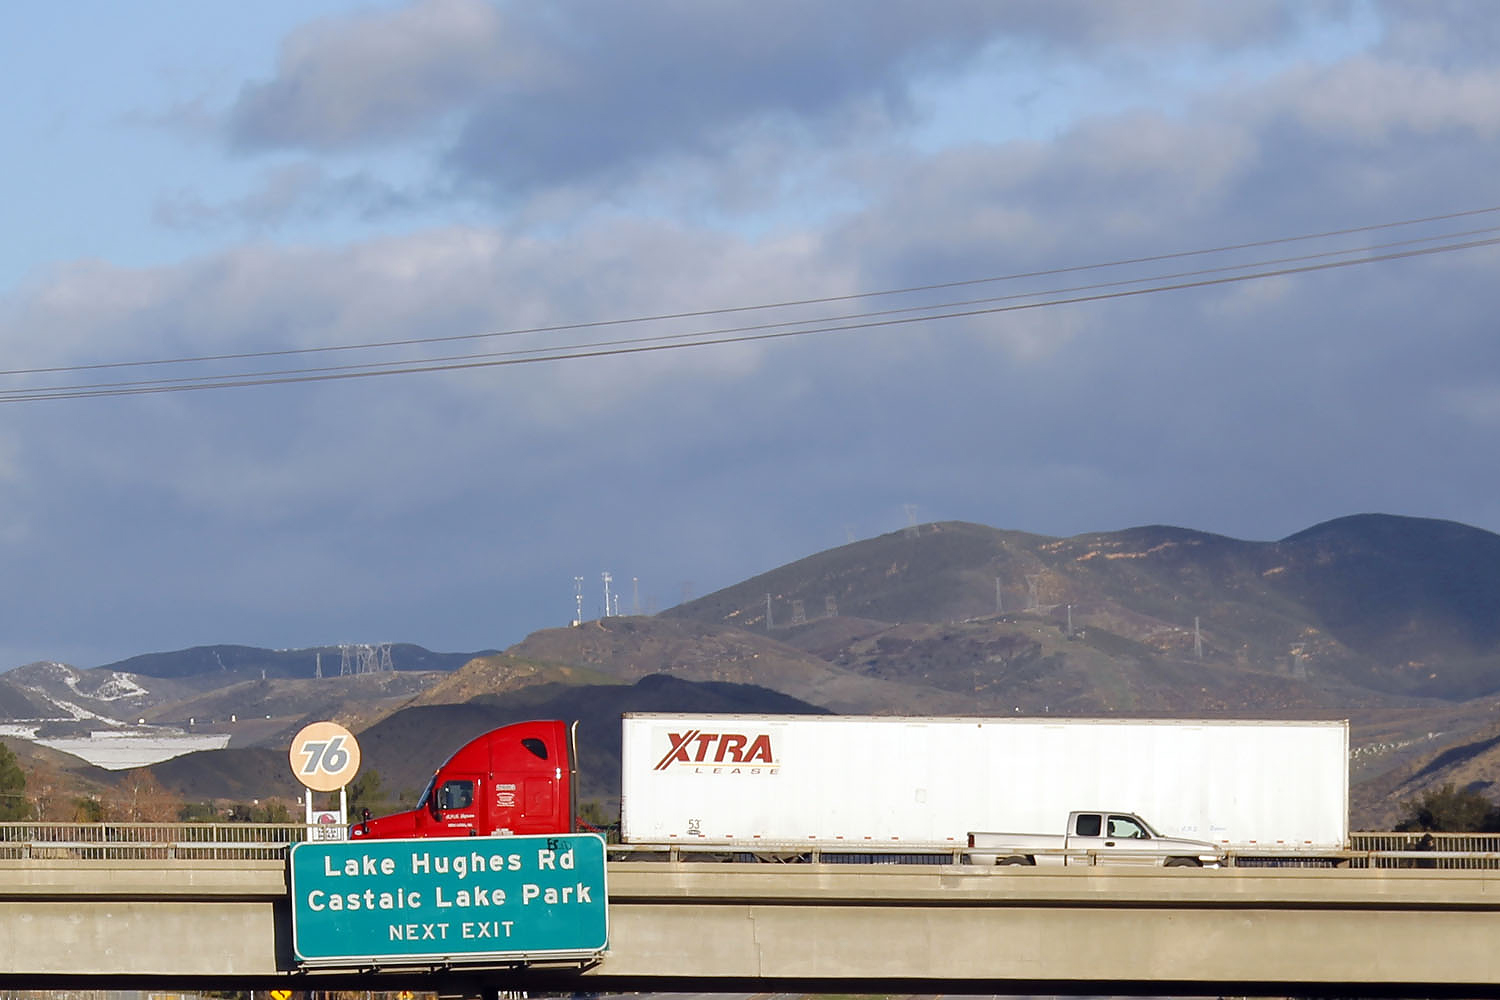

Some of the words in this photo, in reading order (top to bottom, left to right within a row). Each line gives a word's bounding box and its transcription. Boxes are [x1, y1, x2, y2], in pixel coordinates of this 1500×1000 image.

[300, 735, 350, 775] 76
[653, 730, 773, 770] XTRA
[694, 767, 780, 775] LEASE
[324, 854, 396, 877] Lake
[411, 851, 522, 879] Hughes
[538, 848, 575, 870] Rd
[308, 888, 422, 912] Castaic
[435, 885, 507, 908] Lake
[522, 883, 592, 905] Park
[389, 923, 449, 941] NEXT
[462, 921, 514, 939] EXIT
